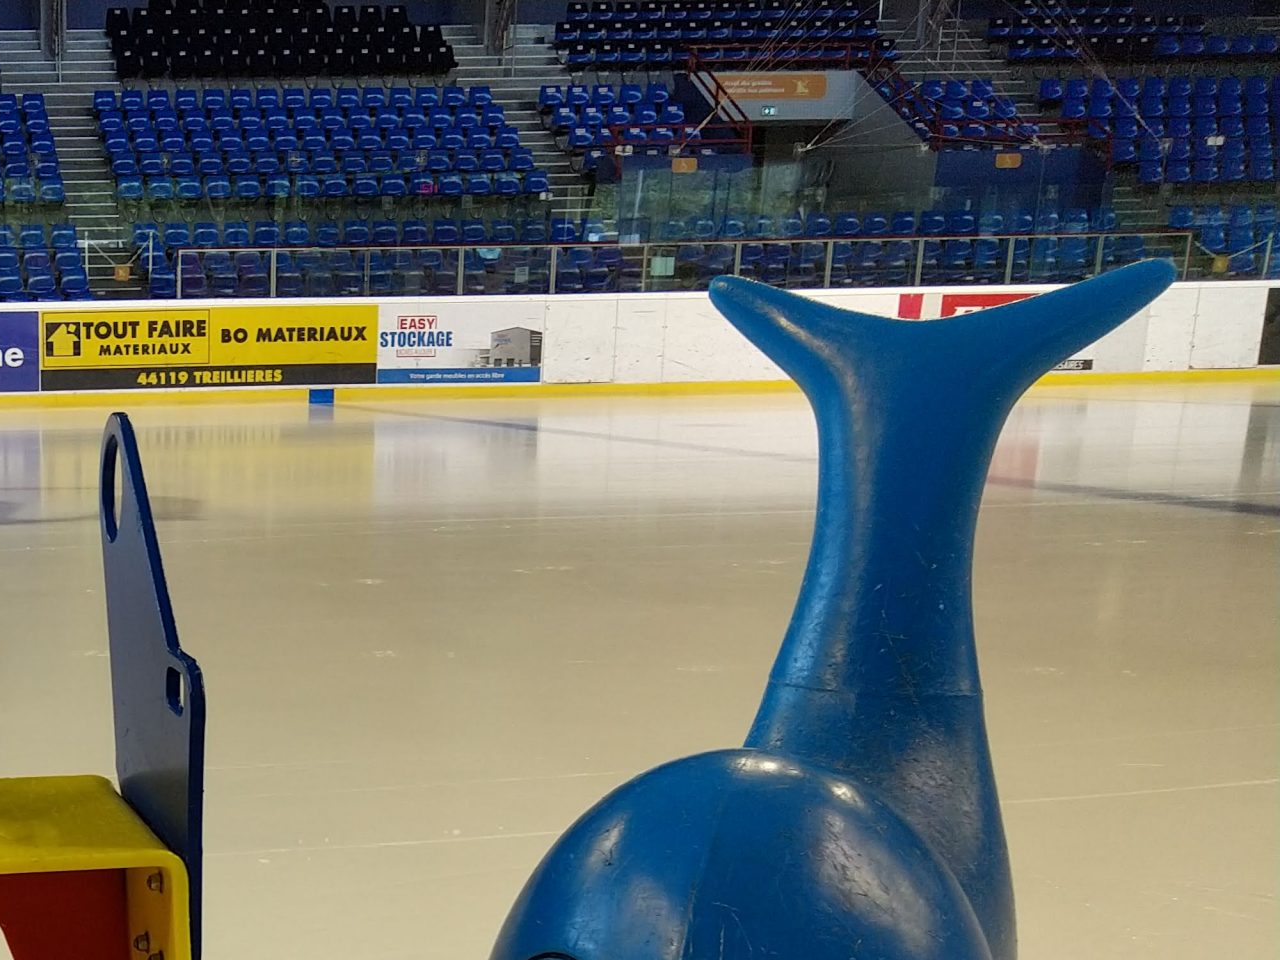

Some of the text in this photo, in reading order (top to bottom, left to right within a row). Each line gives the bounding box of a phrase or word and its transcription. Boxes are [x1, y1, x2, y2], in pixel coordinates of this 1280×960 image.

[83, 320, 207, 339] TOUT FAIRE
[400, 318, 435, 330] EASY
[221, 326, 367, 343] BO MATERIAUX
[380, 331, 453, 348] STOCKAGE
[99, 343, 191, 356] MATERIAUX
[137, 369, 283, 385] 44119 TREILLIERES
